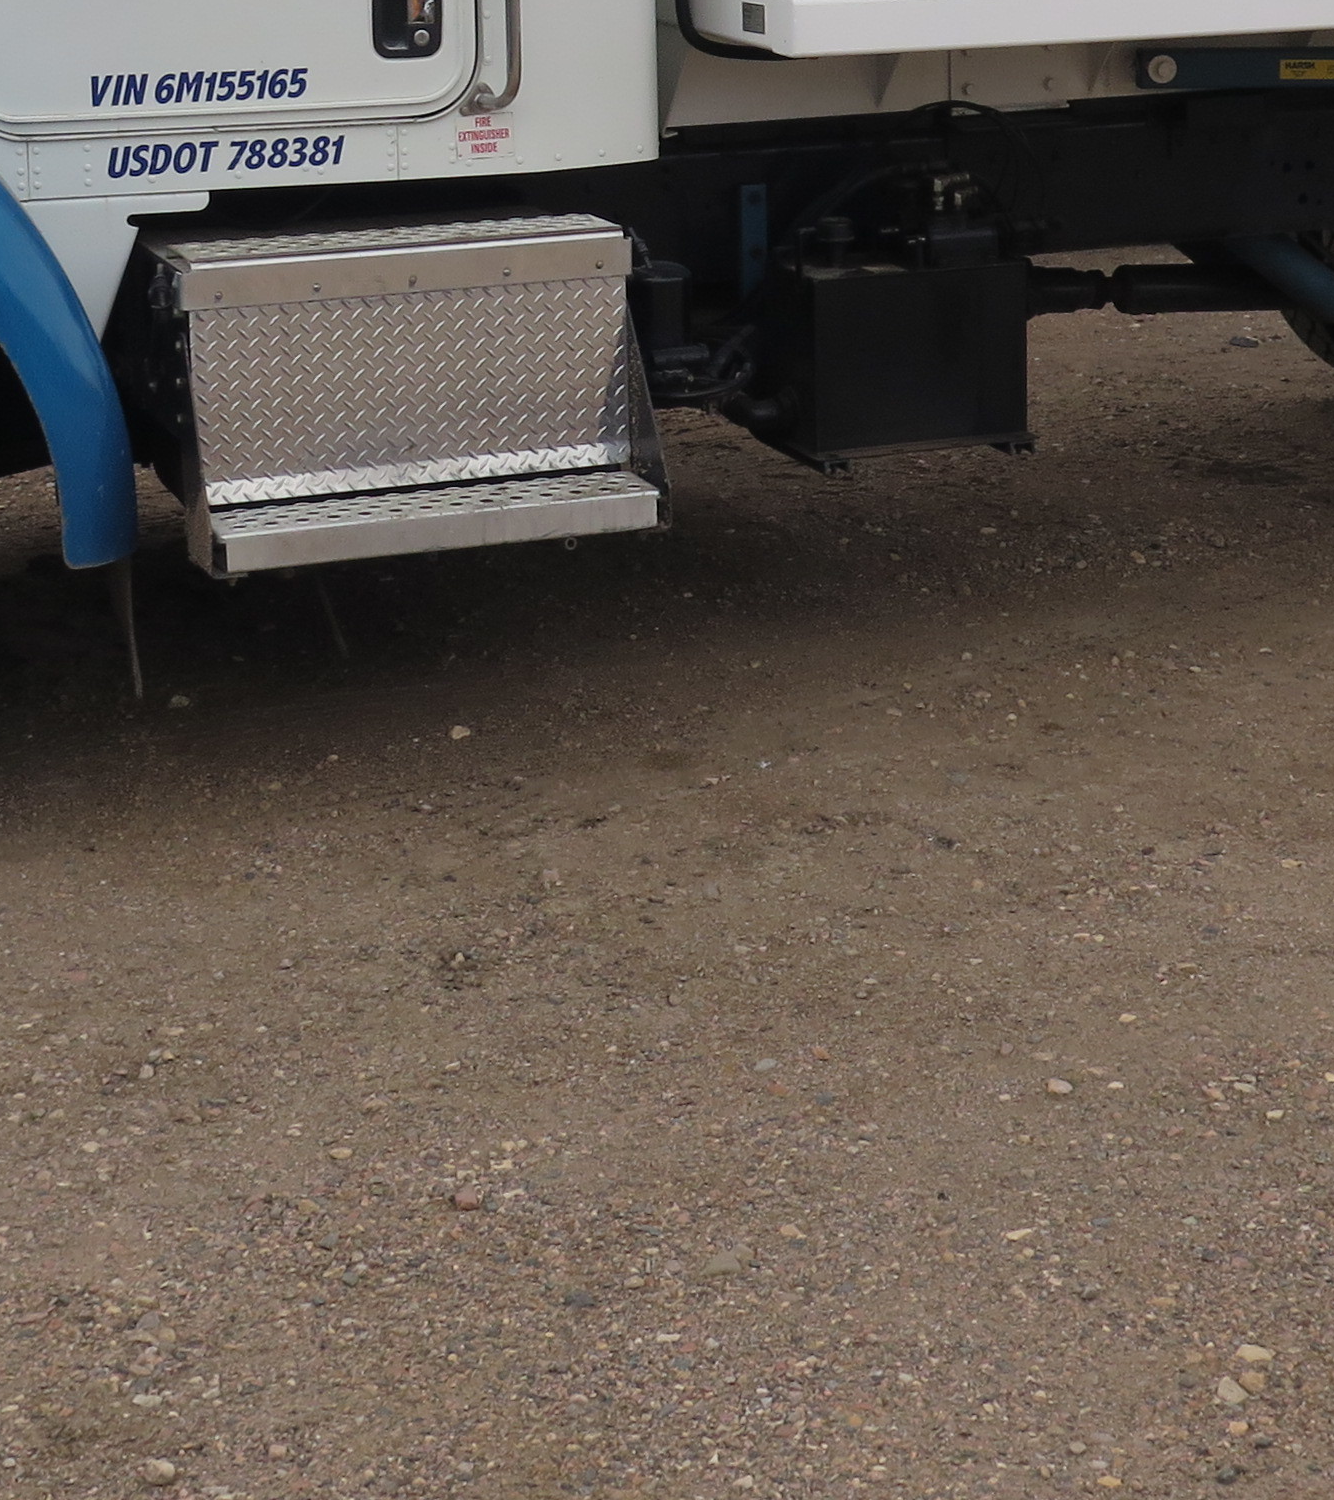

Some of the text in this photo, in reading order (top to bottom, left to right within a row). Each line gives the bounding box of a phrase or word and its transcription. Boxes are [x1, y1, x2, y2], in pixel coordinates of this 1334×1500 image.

[89, 67, 308, 107] VIN 6M155165
[475, 115, 492, 128] FIRE
[458, 128, 510, 142] EXTINGUISHER
[471, 141, 498, 154] INSIDE
[107, 134, 346, 179] USDOT 788381
